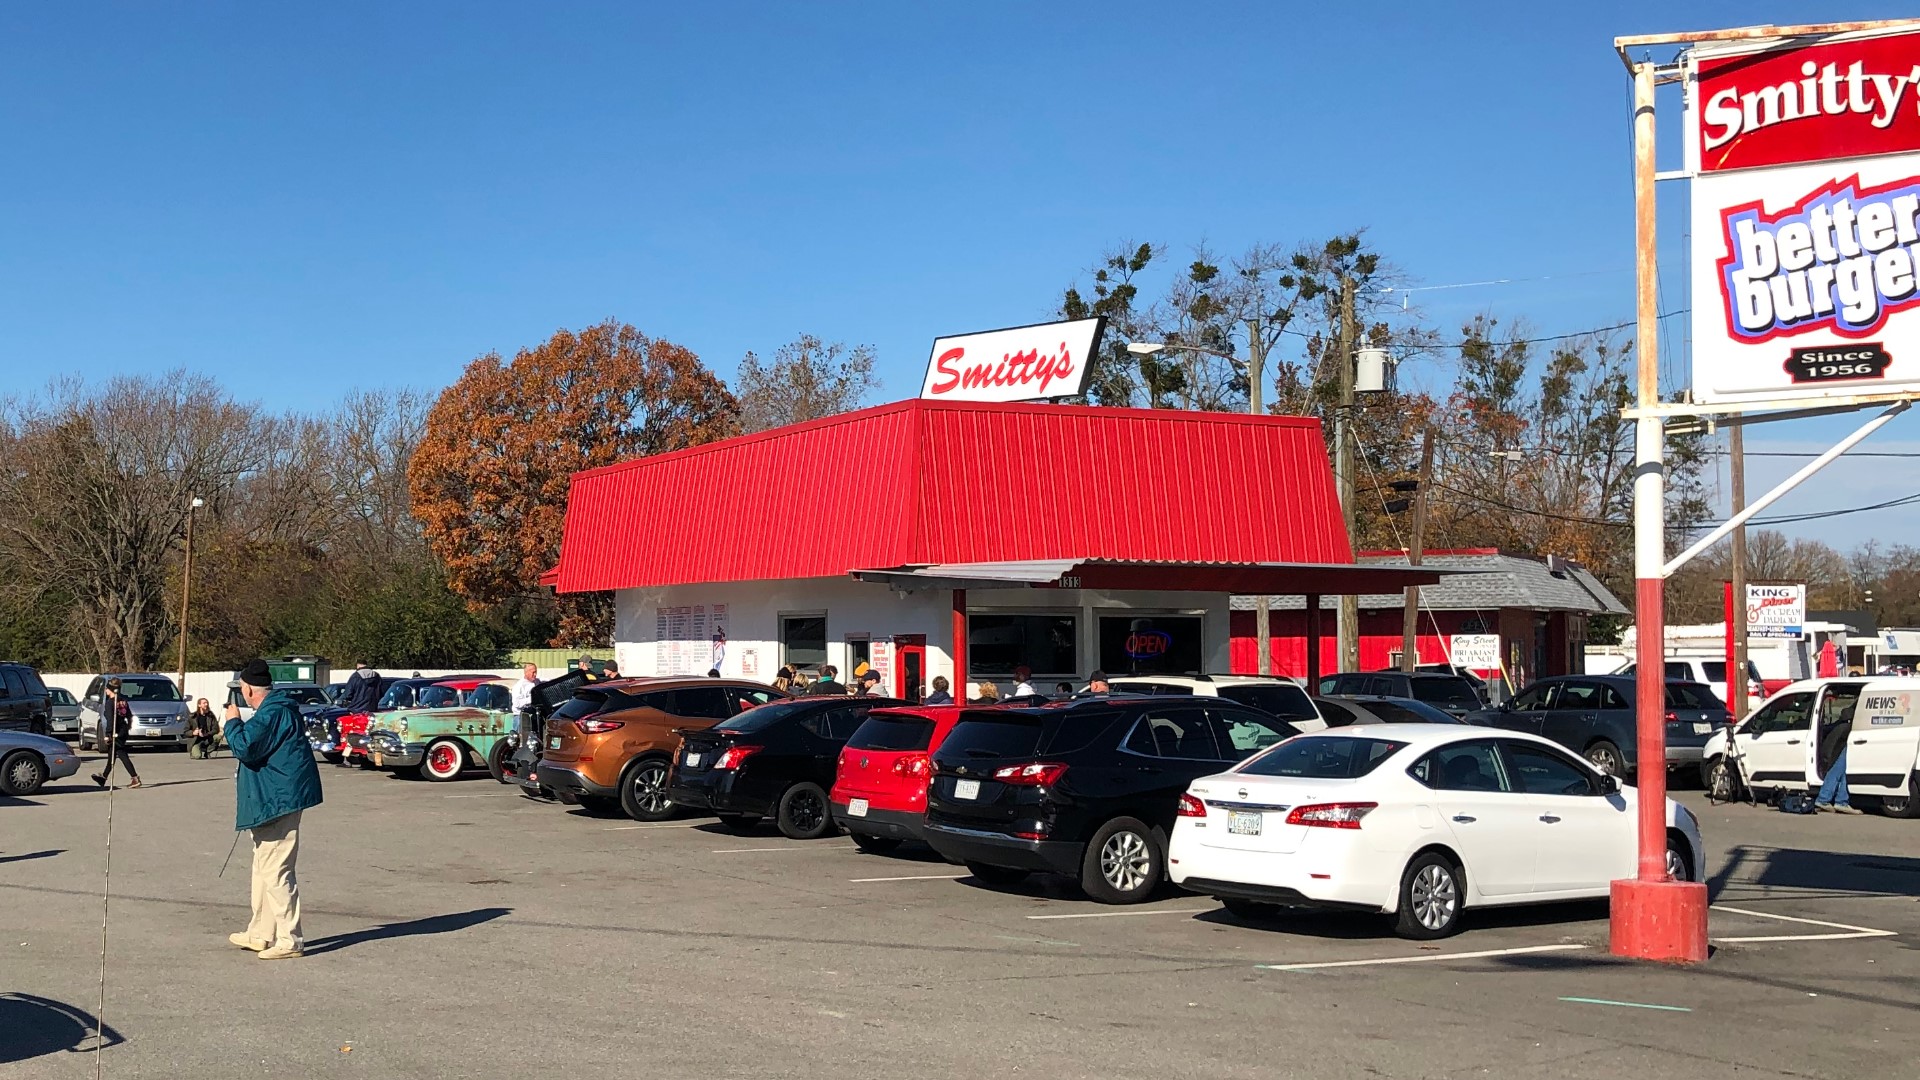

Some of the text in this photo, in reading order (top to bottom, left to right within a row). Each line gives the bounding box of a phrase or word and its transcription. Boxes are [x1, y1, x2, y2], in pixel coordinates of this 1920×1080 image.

[1704, 60, 1920, 152] Smitty'
[1801, 351, 1874, 364] Since
[931, 341, 1075, 394] Smitty's
[1806, 363, 1872, 378] 1956
[1058, 576, 1081, 588] 1313
[1751, 588, 1789, 597] KING
[1125, 635, 1168, 654] OPEN
[1453, 636, 1496, 647] King Street
[1865, 696, 1897, 709] NEWS
